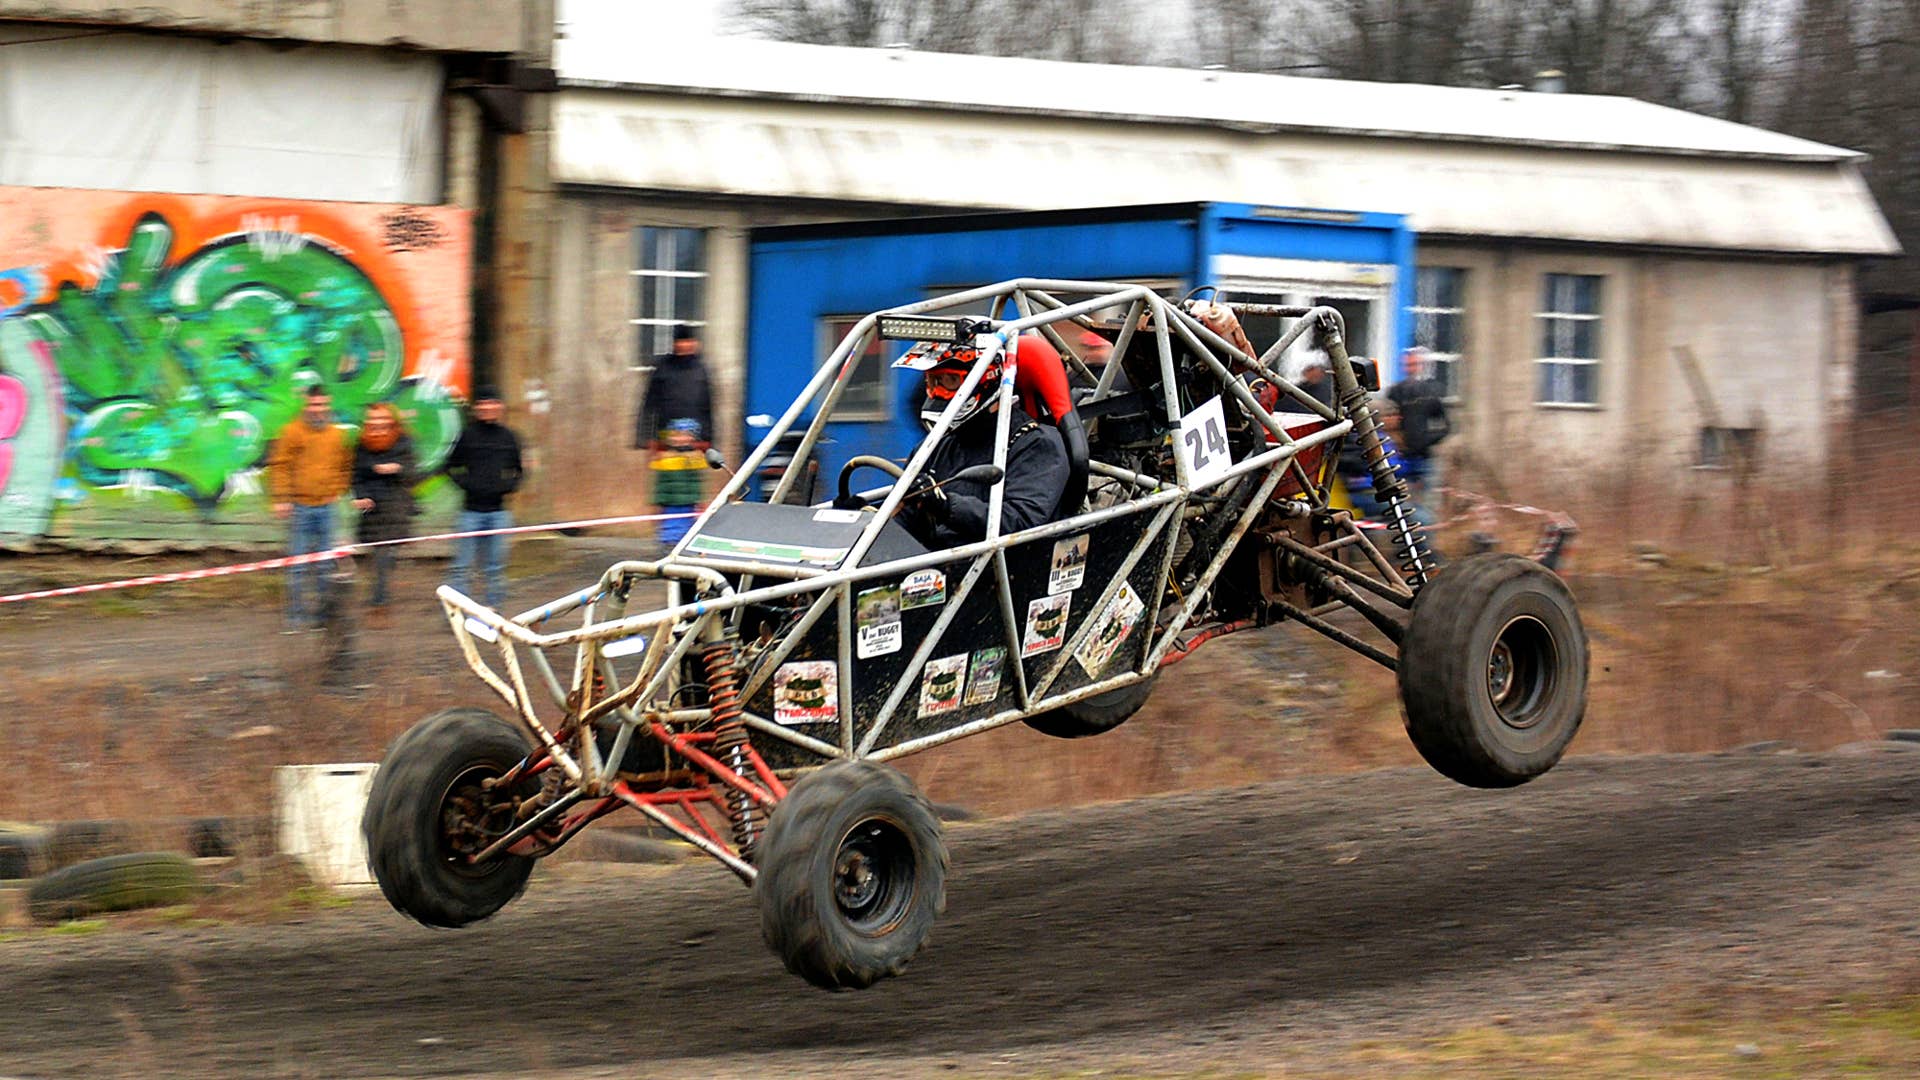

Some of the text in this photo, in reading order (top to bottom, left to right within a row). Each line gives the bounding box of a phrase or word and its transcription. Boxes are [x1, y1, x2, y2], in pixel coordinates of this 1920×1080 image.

[1185, 417, 1225, 471] 24
[861, 627, 868, 641] V
[878, 624, 899, 637] BUGGY
